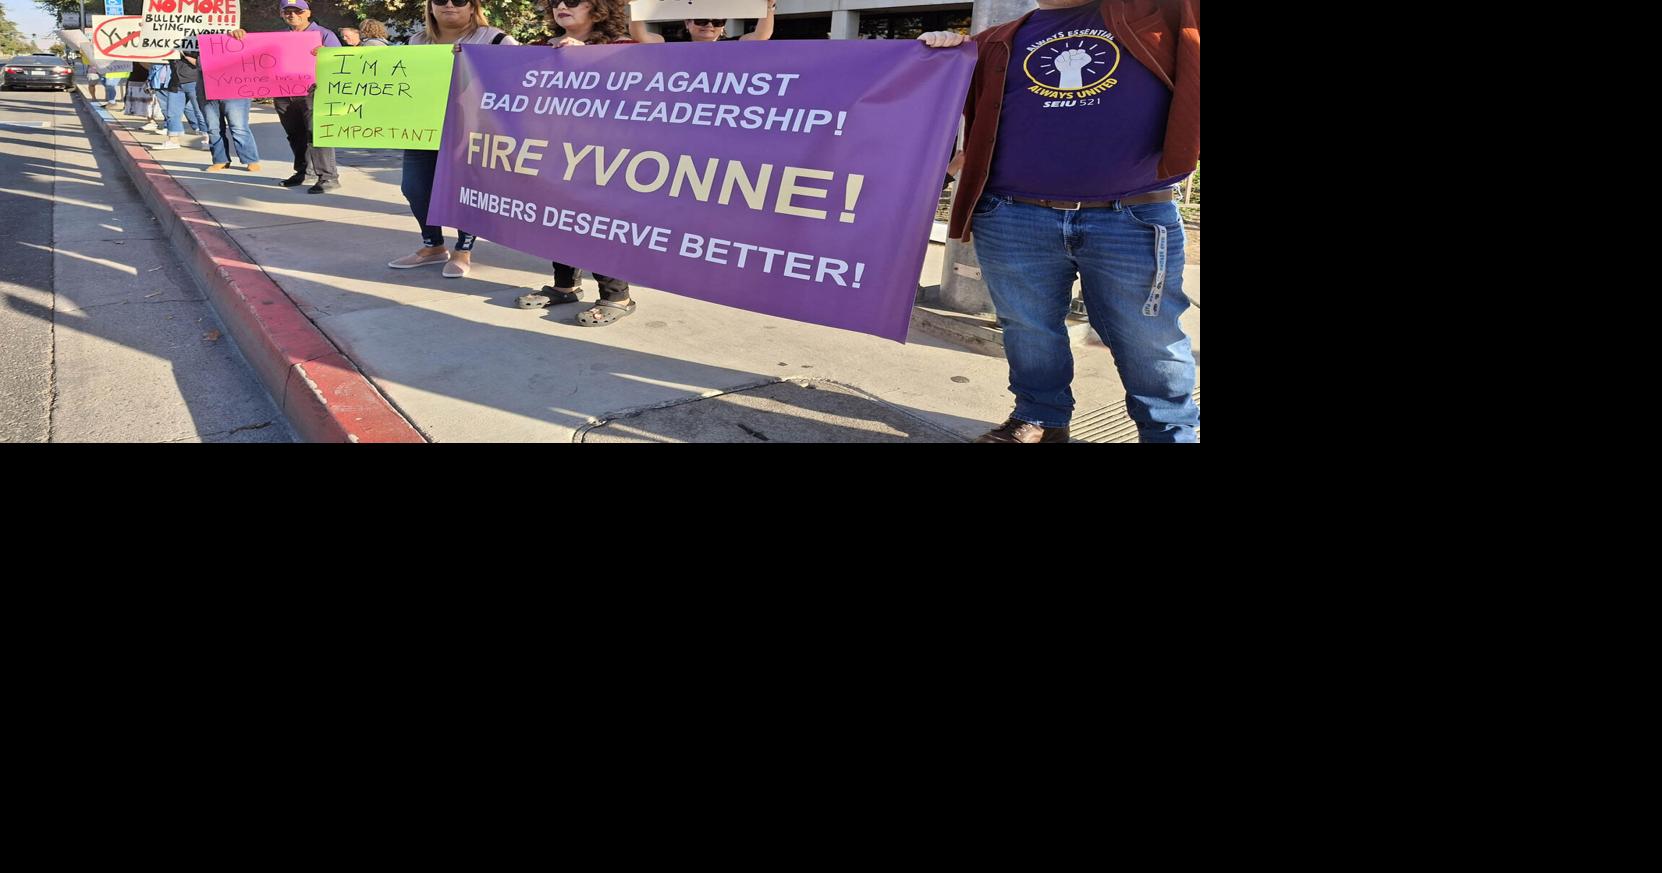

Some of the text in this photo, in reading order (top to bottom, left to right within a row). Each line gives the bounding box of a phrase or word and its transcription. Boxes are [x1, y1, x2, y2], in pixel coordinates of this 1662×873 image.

[148, 0, 236, 14] NO MORE
[145, 14, 202, 24] BULLYING
[153, 23, 184, 31] LYING
[142, 38, 170, 48] BACK
[209, 36, 244, 56] HO
[1026, 28, 1115, 51] ALWAYS ESSENTIAL
[241, 53, 277, 72] HO
[332, 54, 408, 77] I'M A
[238, 85, 271, 97] GO
[328, 81, 413, 98] MEMBER
[522, 70, 800, 97] STAND UP AGAINST
[1027, 78, 1118, 99] ALWAYS UNITED
[324, 102, 363, 119] I'M
[1042, 97, 1100, 108] SEIU 521
[480, 92, 848, 136] BAD UNION LEADERSHIP!
[319, 124, 438, 142] IMPORTANT
[467, 131, 865, 224] FIRE YVONNE!
[459, 186, 866, 289] MEMBERS DESERVE BETTER!
